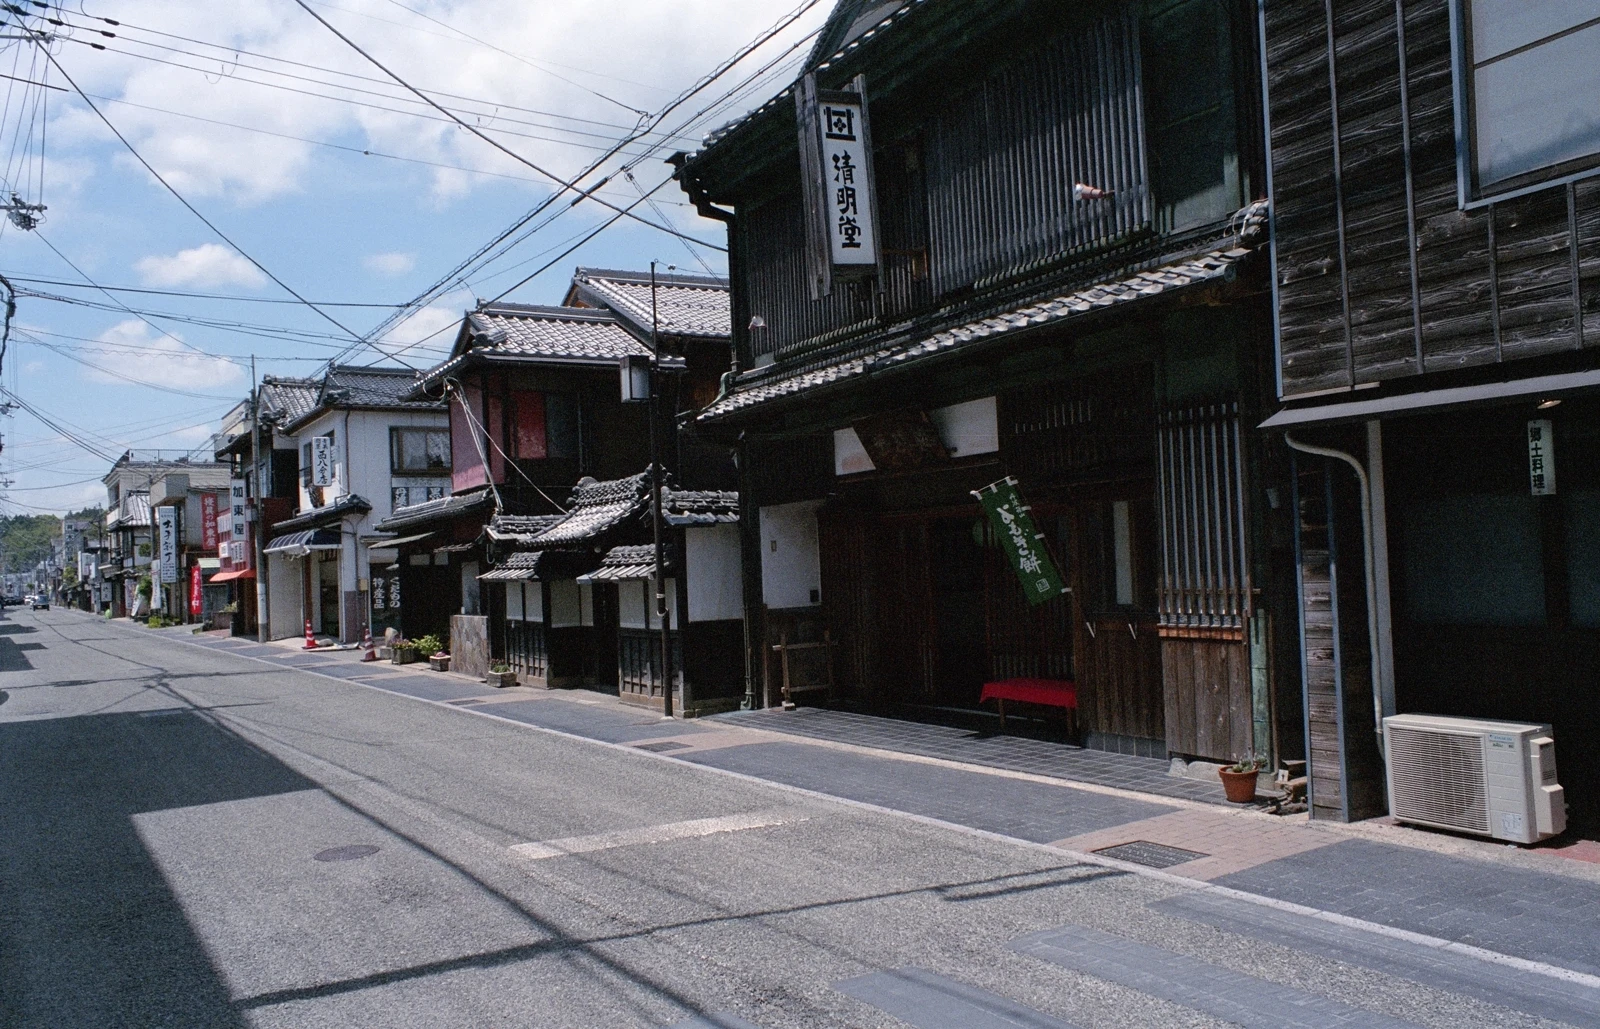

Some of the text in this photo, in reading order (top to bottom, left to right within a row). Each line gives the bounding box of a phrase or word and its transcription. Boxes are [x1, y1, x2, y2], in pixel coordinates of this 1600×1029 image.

[832, 150, 862, 248] 清明堂
[1529, 426, 1545, 489] 郷土料理
[233, 486, 244, 535] 加東屋
[996, 504, 1041, 574] よもぎ餅
[372, 577, 384, 609] 特産品
[390, 576, 400, 608] くだもの
